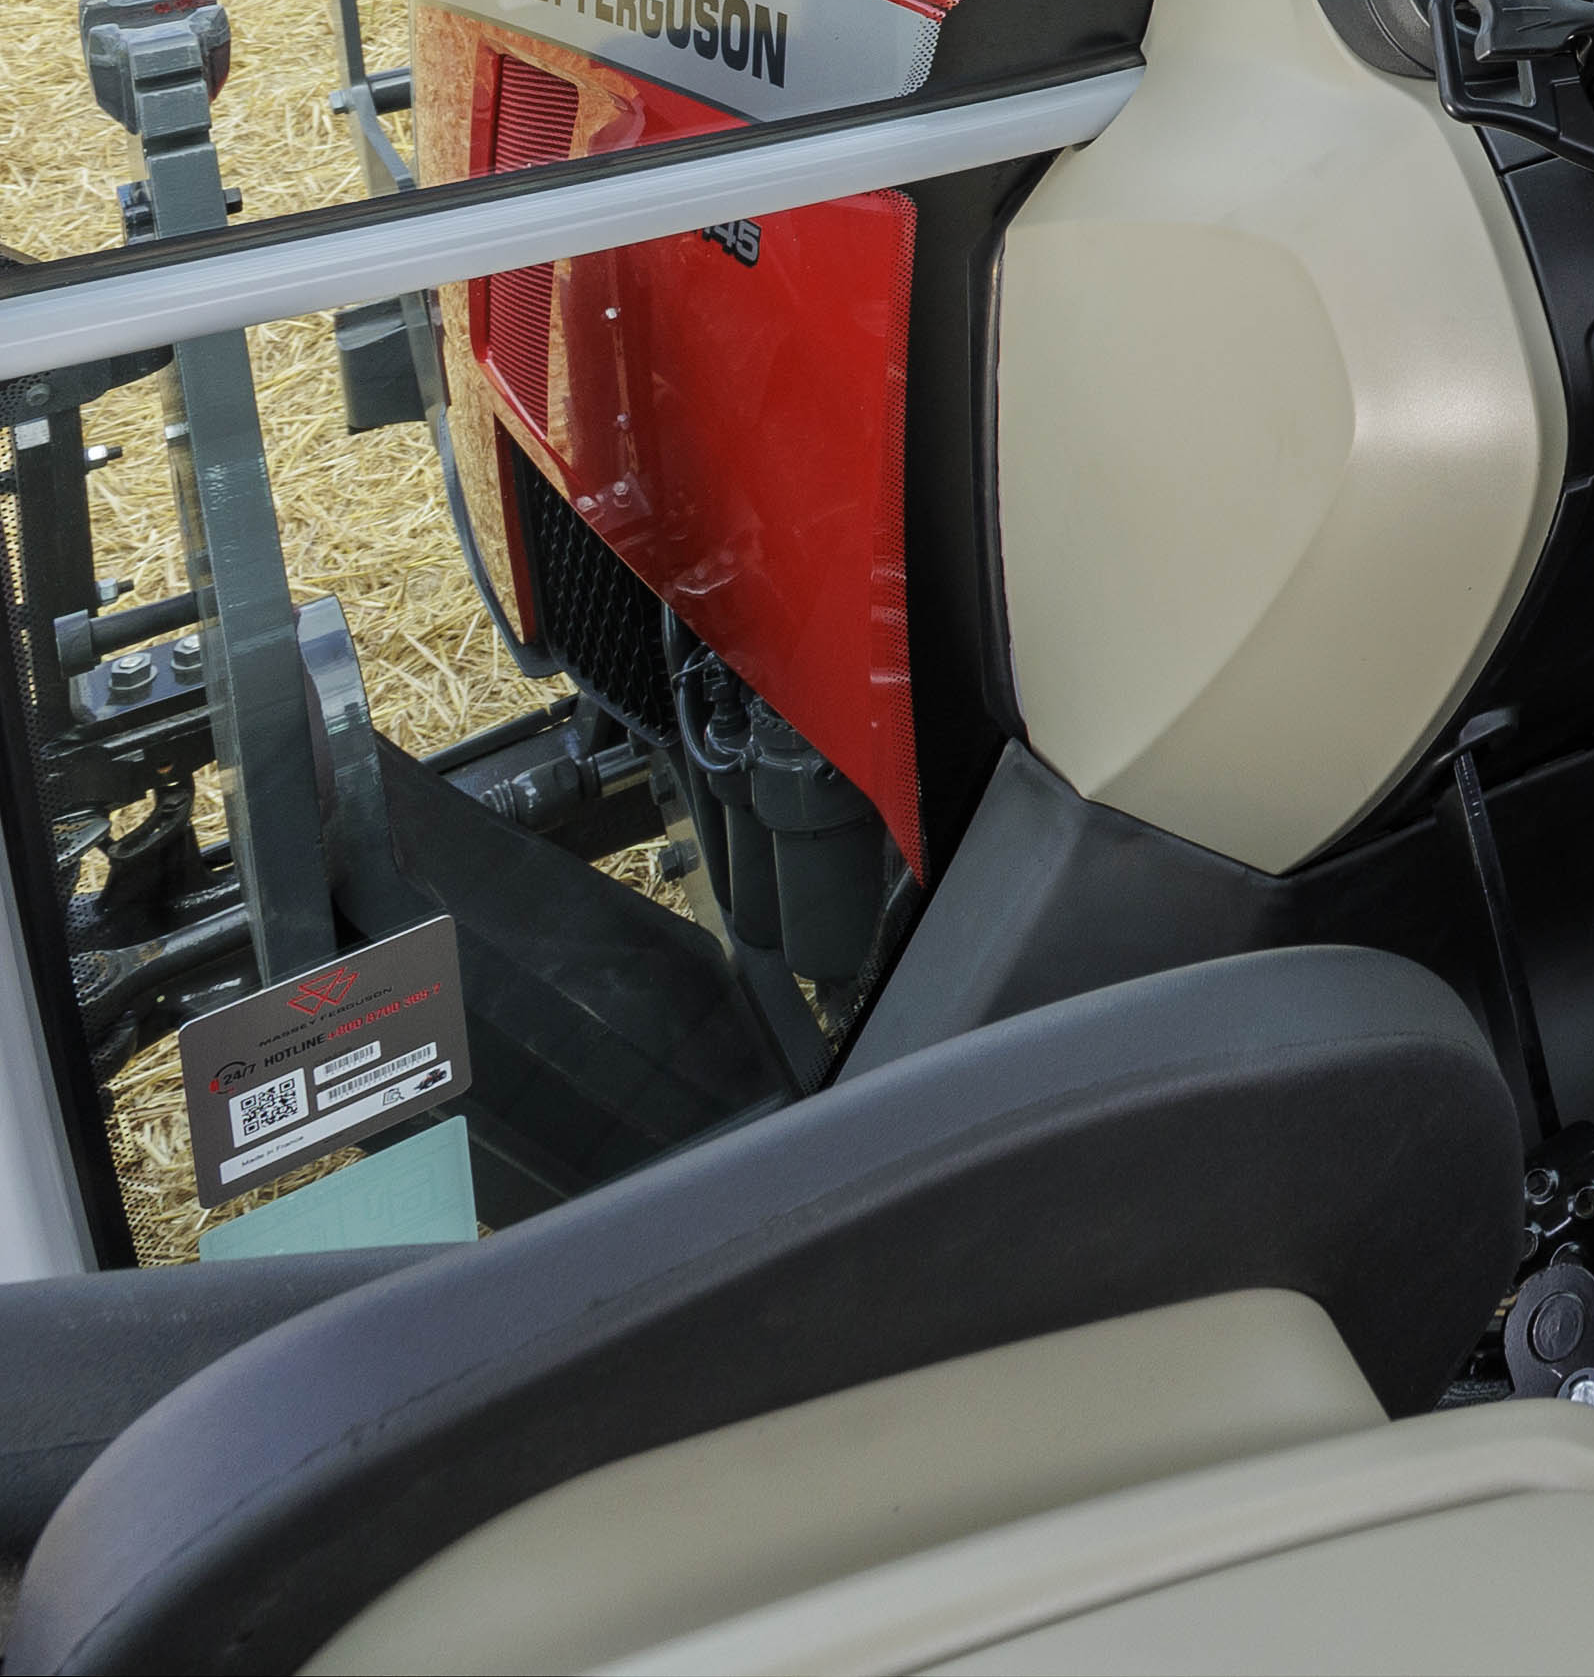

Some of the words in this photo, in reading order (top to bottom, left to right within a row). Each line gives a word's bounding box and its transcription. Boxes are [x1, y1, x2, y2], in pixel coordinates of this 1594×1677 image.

[702, 218, 761, 268] 45
[259, 1020, 317, 1048] MASSEY
[319, 985, 393, 1021] FERGUSON
[223, 1063, 257, 1086] 24/7
[263, 1032, 328, 1068] HOTLINE
